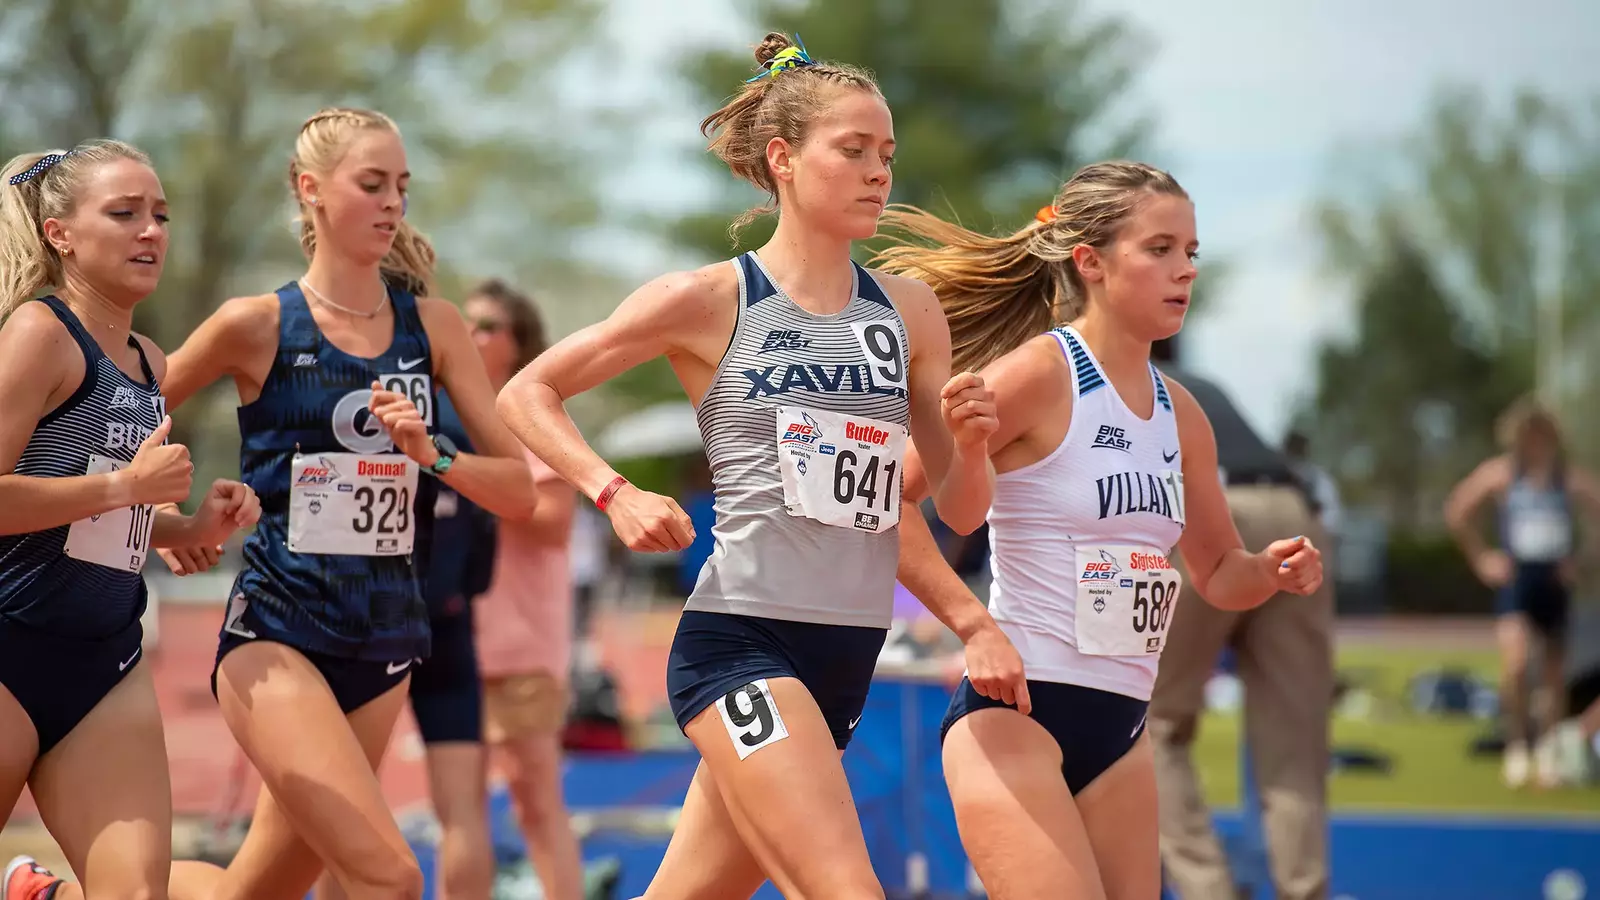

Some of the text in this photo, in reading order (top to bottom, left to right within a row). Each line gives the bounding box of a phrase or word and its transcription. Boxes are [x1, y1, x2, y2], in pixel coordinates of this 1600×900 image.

[767, 330, 802, 340] BIG
[760, 339, 813, 350] EAST
[863, 324, 903, 383] 9
[740, 364, 908, 401] XAVI
[115, 386, 136, 398] BIG
[110, 396, 140, 408] EAST
[787, 423, 814, 435] BIG
[845, 421, 890, 447] Butler
[1098, 424, 1125, 438] BIG
[782, 431, 819, 444] EAST
[1093, 434, 1133, 450] EAST
[302, 467, 329, 477] BIG
[297, 475, 335, 485] EAST
[833, 449, 896, 512] 641
[352, 486, 409, 534] 329
[126, 503, 154, 553] 101
[855, 520, 878, 530] CHANGE
[1085, 562, 1112, 572] BIG
[1081, 571, 1118, 580] EAST
[1132, 580, 1177, 633] 588
[724, 683, 775, 747] 9
